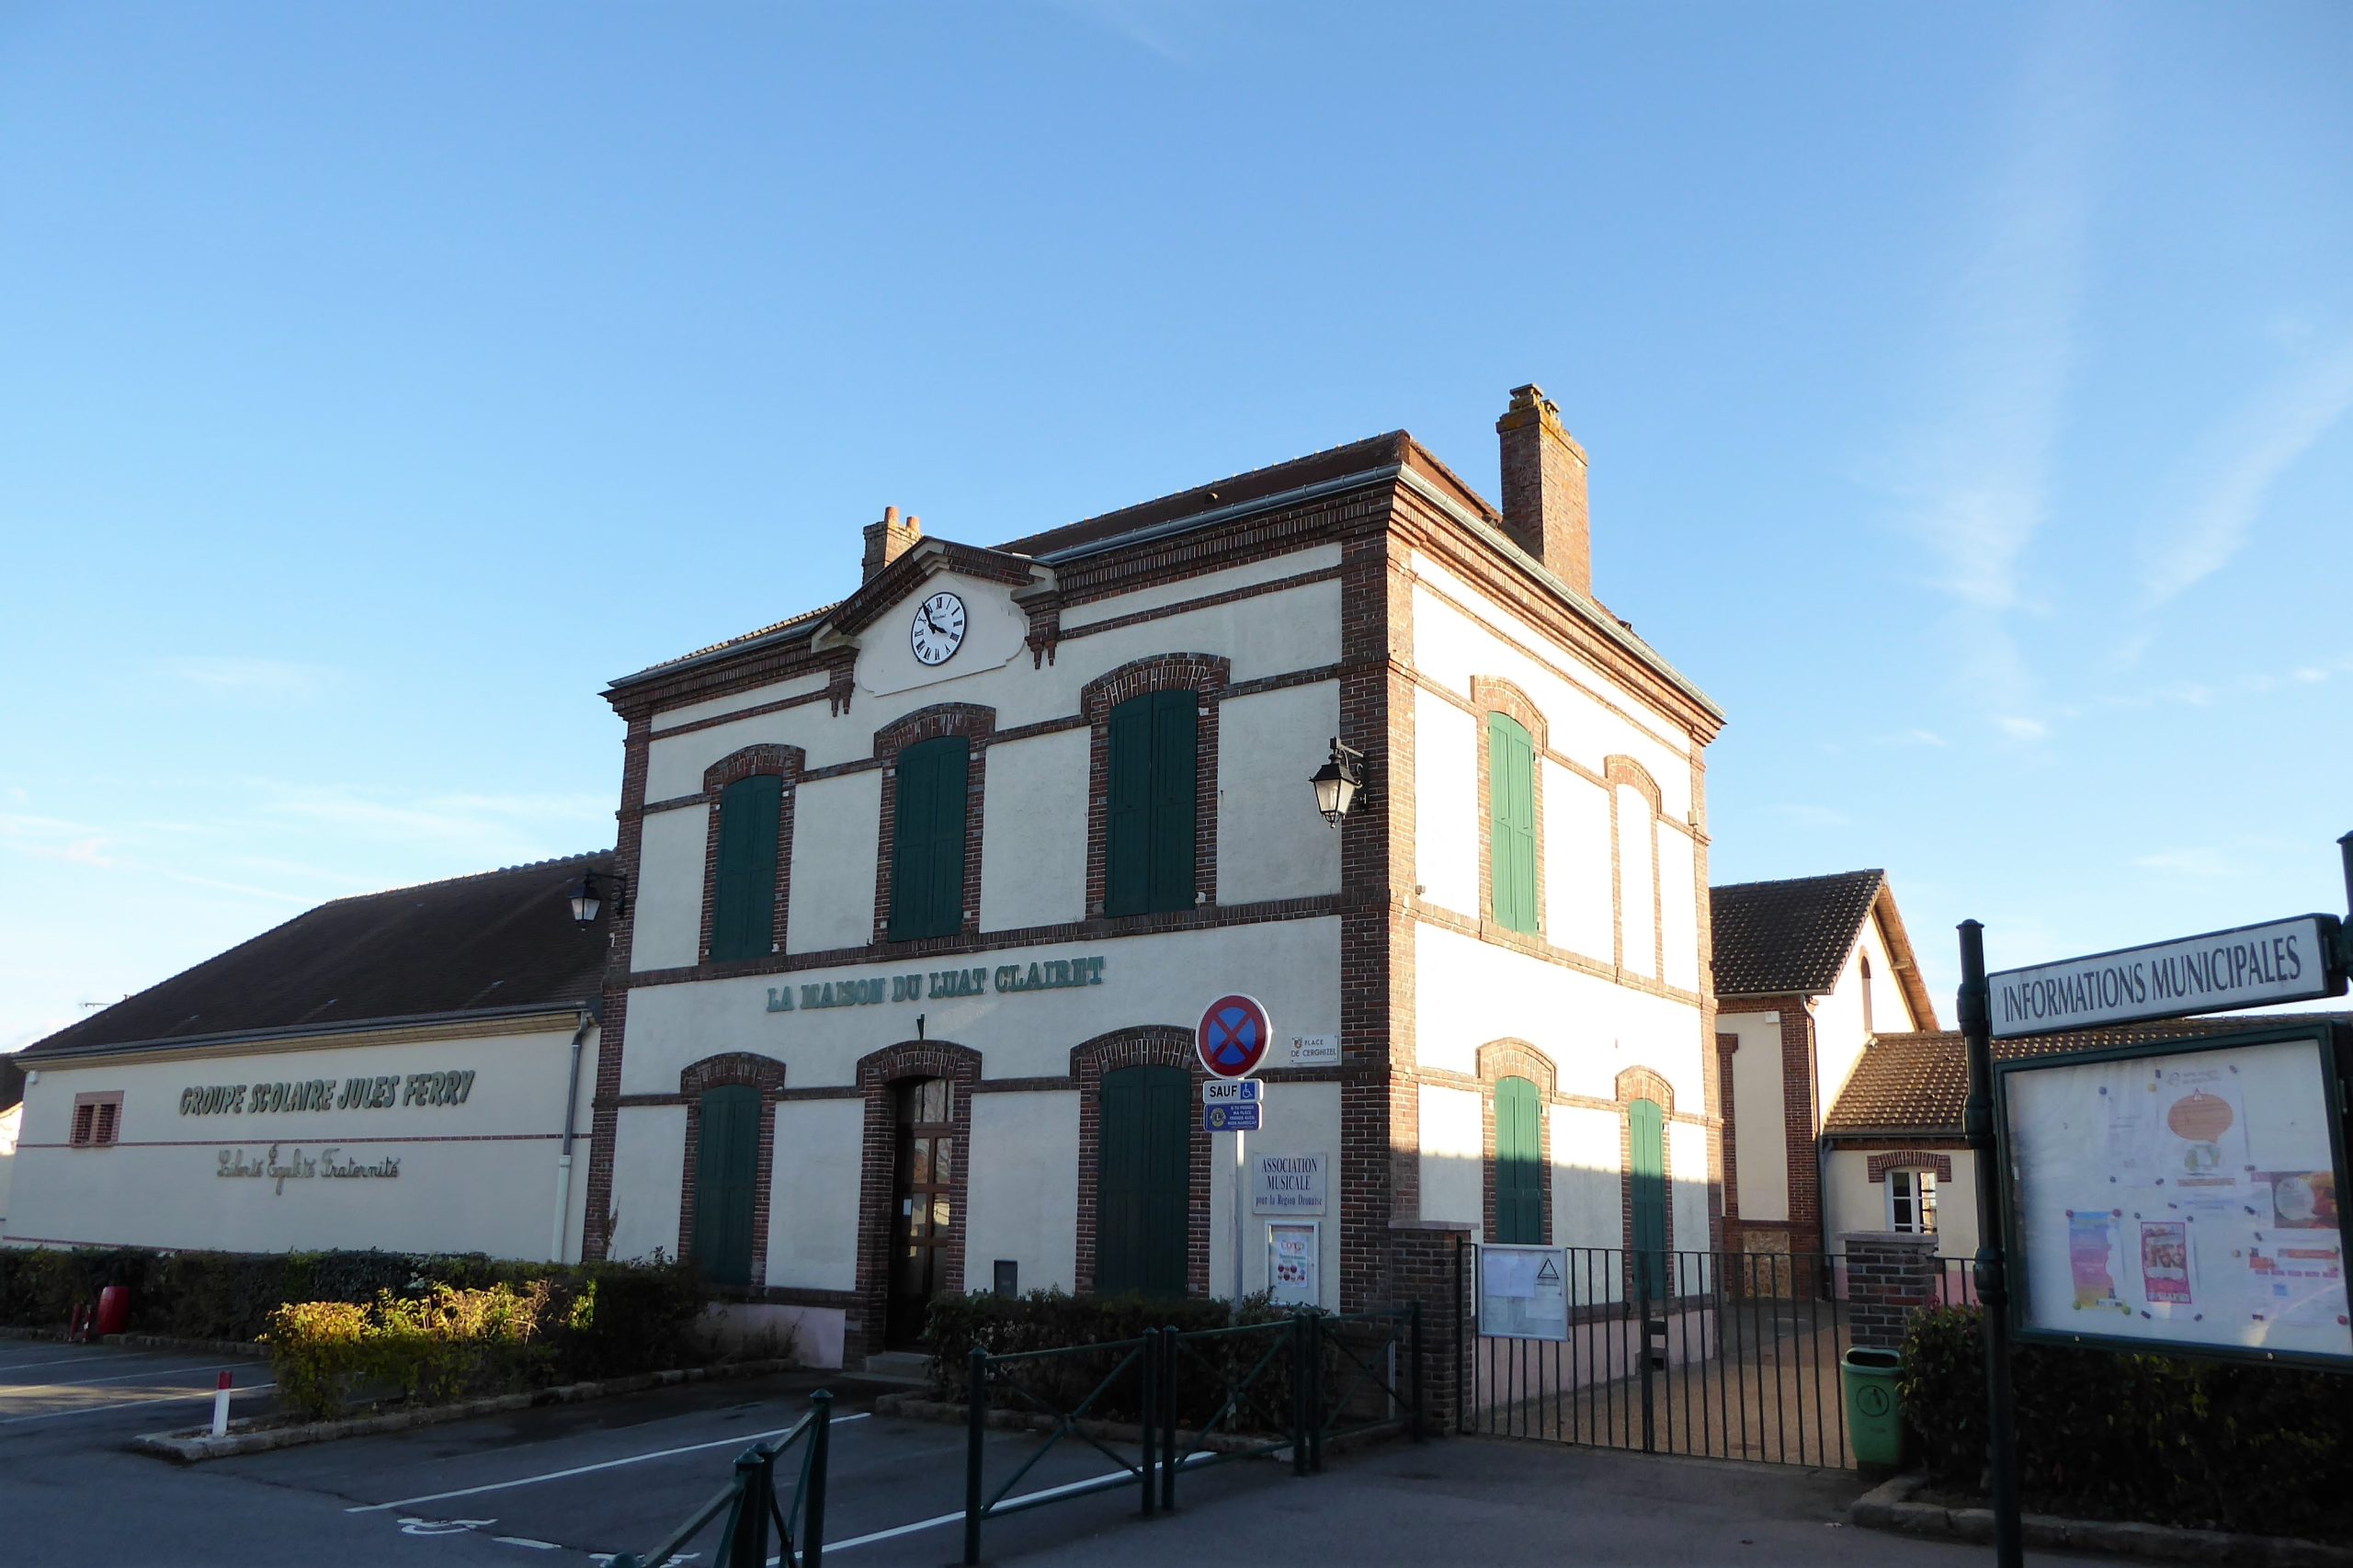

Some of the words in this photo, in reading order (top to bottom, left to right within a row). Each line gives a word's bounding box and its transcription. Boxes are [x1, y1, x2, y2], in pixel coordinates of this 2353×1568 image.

[767, 986, 794, 1012] LA
[800, 977, 886, 1010] MAISON
[892, 973, 922, 1003] DU
[928, 967, 987, 999] LUAT
[994, 955, 1106, 994] CLAIRET
[2003, 962, 2146, 1023] INFORMATIONS
[2152, 935, 2302, 1001] MUNICIPALES
[1290, 1050, 1301, 1058] DE
[179, 1085, 247, 1116] GROUPE
[247, 1079, 335, 1113] SCOLAIRE
[336, 1074, 401, 1110] JULES
[402, 1070, 475, 1107] FERRY
[1209, 1085, 1237, 1097] SAUF
[321, 1148, 402, 1178] Fraternité
[1262, 1157, 1317, 1173] ASSOCIATION
[1267, 1176, 1311, 1190] MUSICALE
[1256, 1197, 1267, 1207] pour
[1269, 1195, 1276, 1205] la
